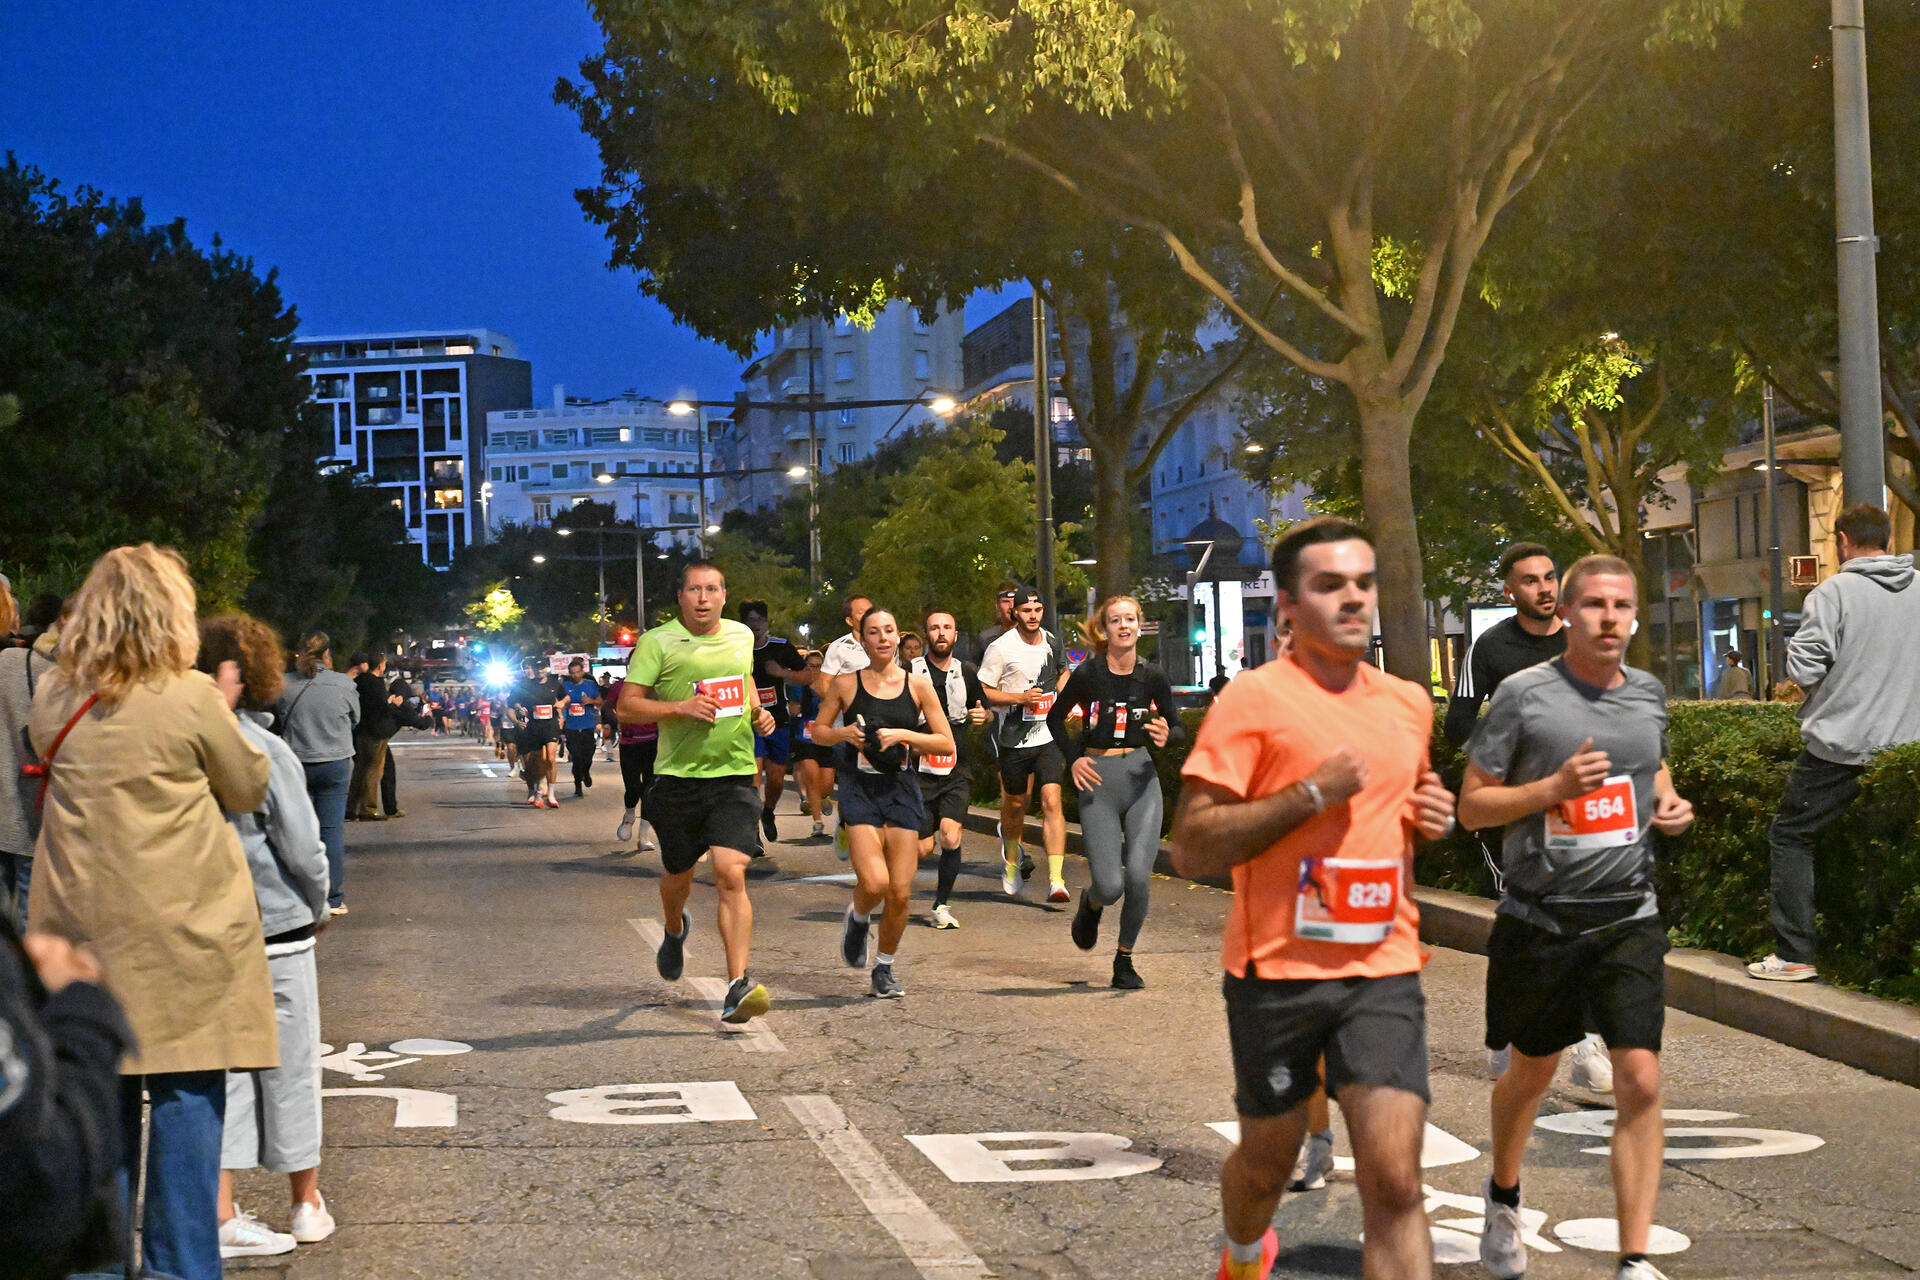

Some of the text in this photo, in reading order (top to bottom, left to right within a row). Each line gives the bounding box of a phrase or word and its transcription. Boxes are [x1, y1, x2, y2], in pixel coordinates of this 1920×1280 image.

[717, 685, 740, 701] 311
[1038, 699, 1052, 709] 511
[1584, 796, 1625, 821] 564
[1347, 881, 1392, 908] 829
